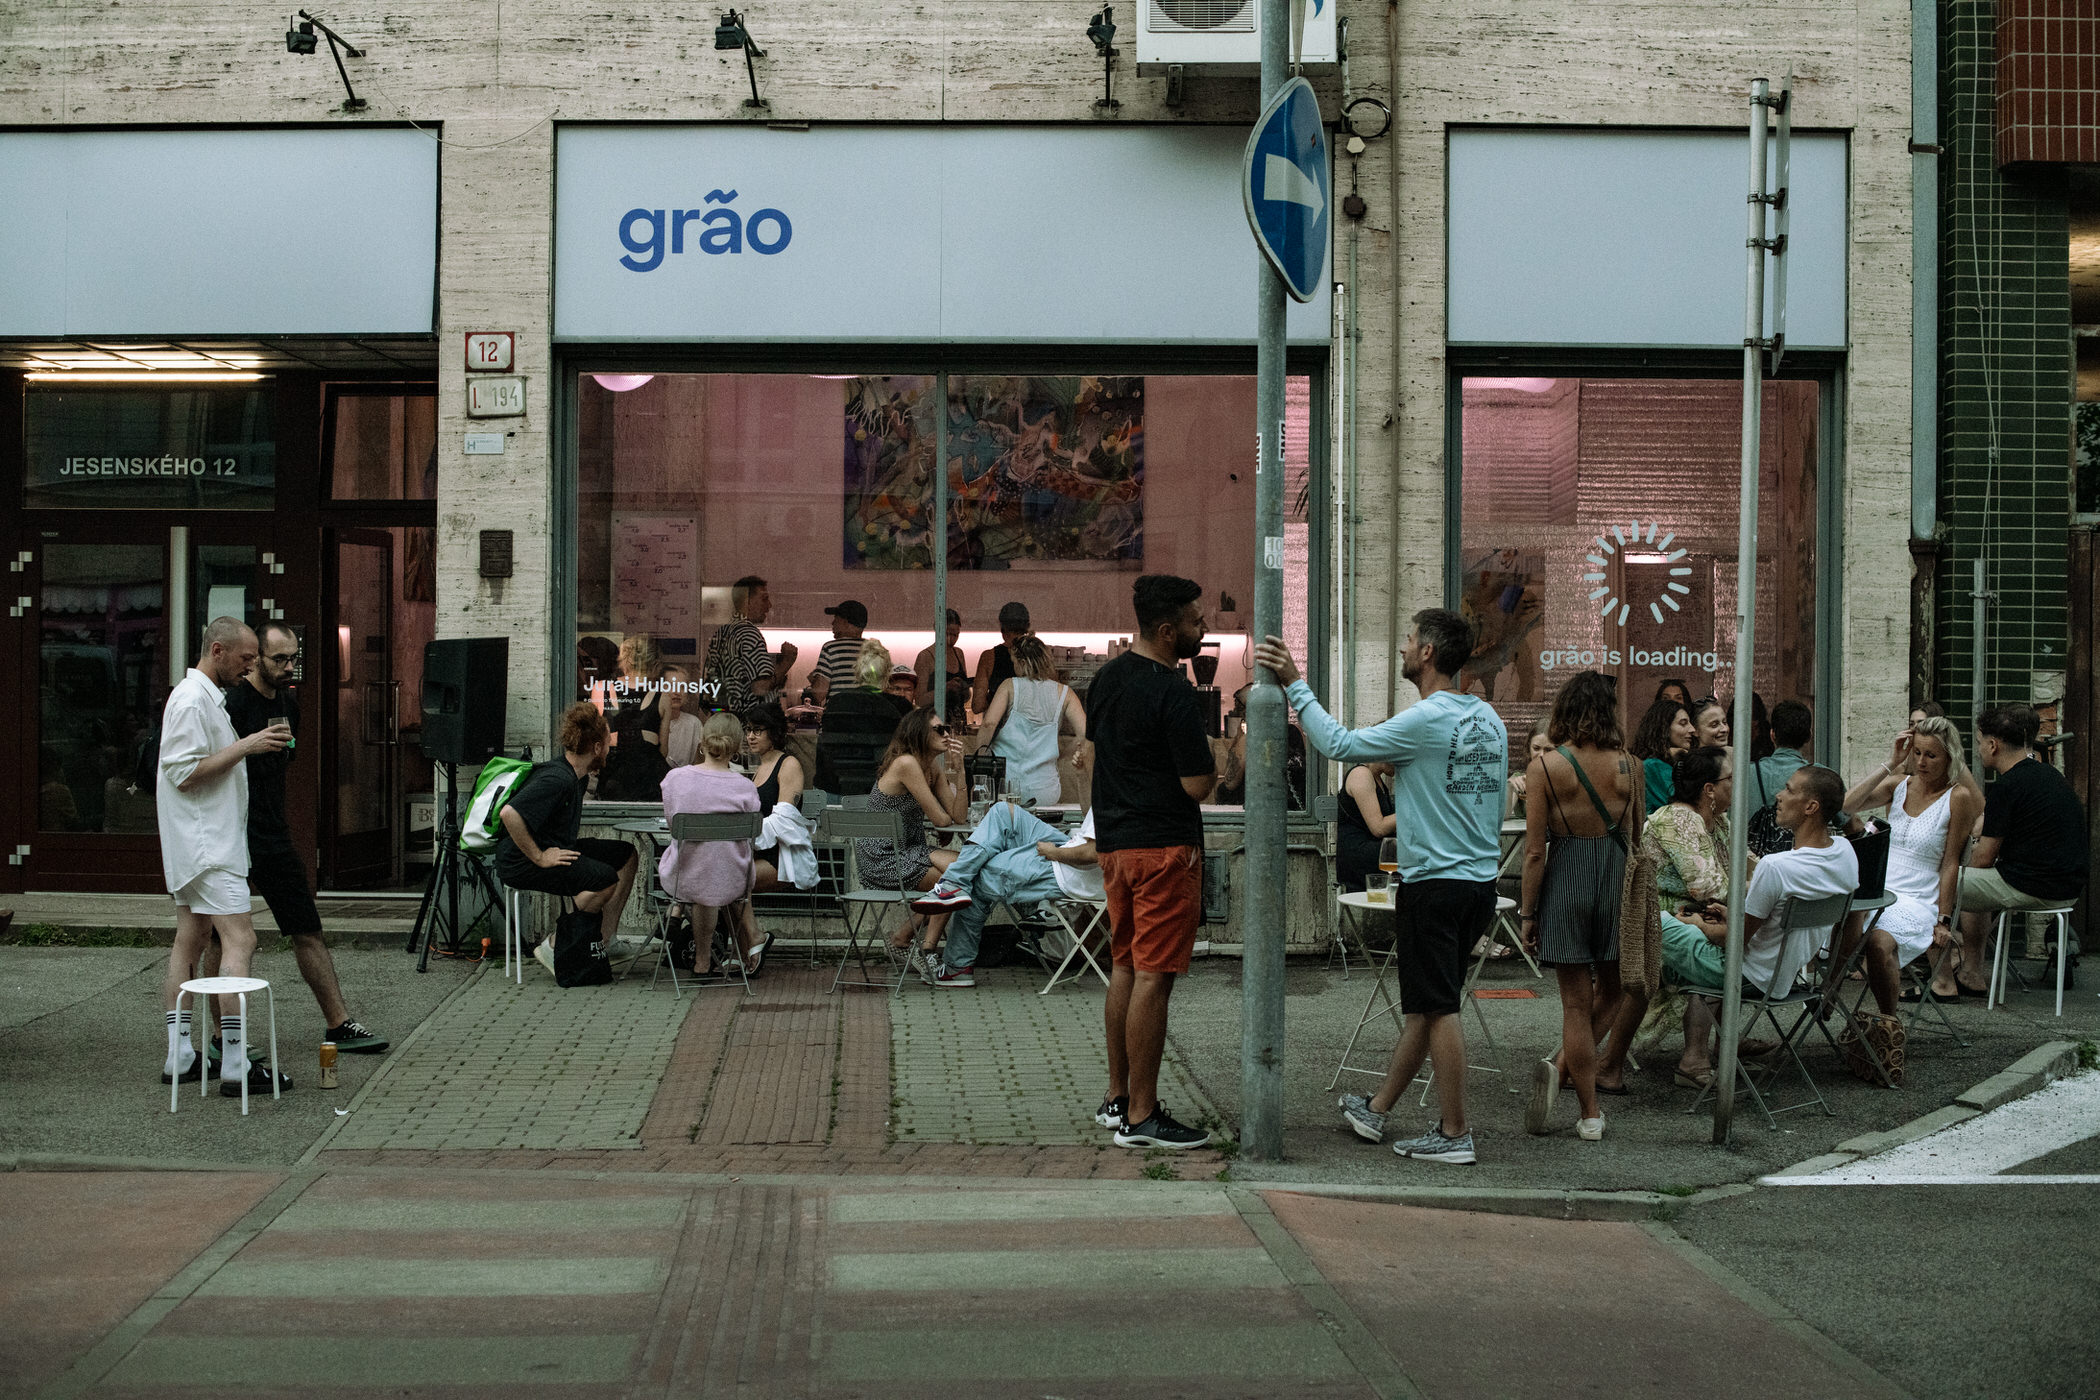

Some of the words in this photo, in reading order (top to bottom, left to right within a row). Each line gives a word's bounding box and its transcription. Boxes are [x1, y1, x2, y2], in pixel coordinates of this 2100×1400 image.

[618, 188, 793, 273] grão
[478, 341, 498, 362] 12
[492, 386, 518, 407] 194
[59, 453, 206, 475] JESENSKÉHO
[213, 458, 236, 475] 12
[1539, 645, 1595, 670] grão
[1602, 645, 1622, 665] is
[583, 675, 629, 695] Juraj
[635, 676, 722, 698] Hubinský
[1450, 726, 1460, 749] HELP
[1448, 750, 1456, 761] TO
[1446, 763, 1454, 780] HOW
